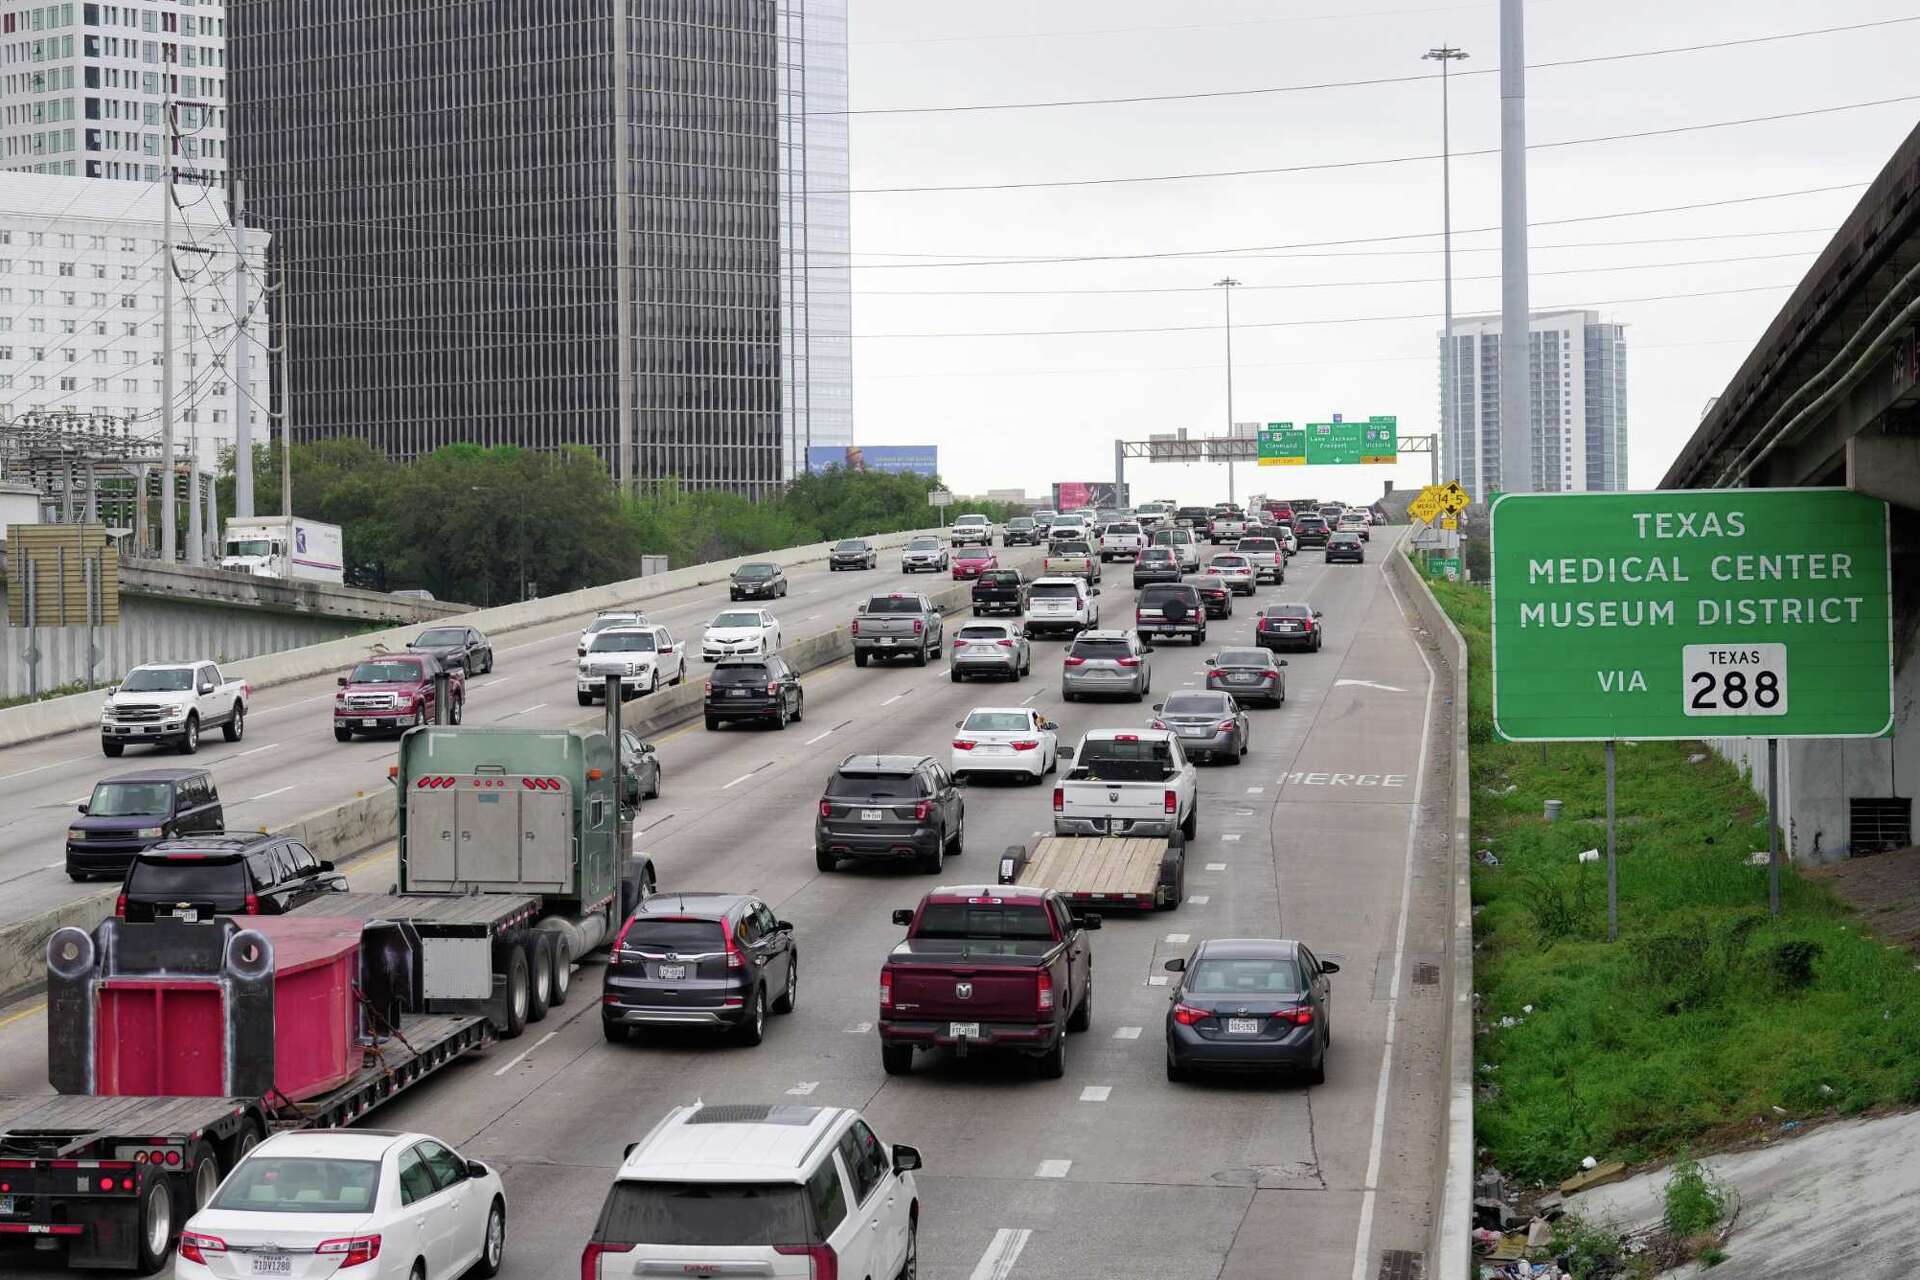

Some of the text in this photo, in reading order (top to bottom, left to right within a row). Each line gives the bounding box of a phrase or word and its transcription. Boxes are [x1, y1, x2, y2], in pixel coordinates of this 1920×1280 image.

[1633, 511, 1746, 539] TEXAS
[1529, 553, 1853, 584] MEDICAL CENTER
[1520, 597, 1863, 628] MUSEUM DISTRICT
[1709, 651, 1760, 665] TEXAS
[1597, 671, 1780, 709] VIA 288
[1276, 771, 1408, 787] MERGE
